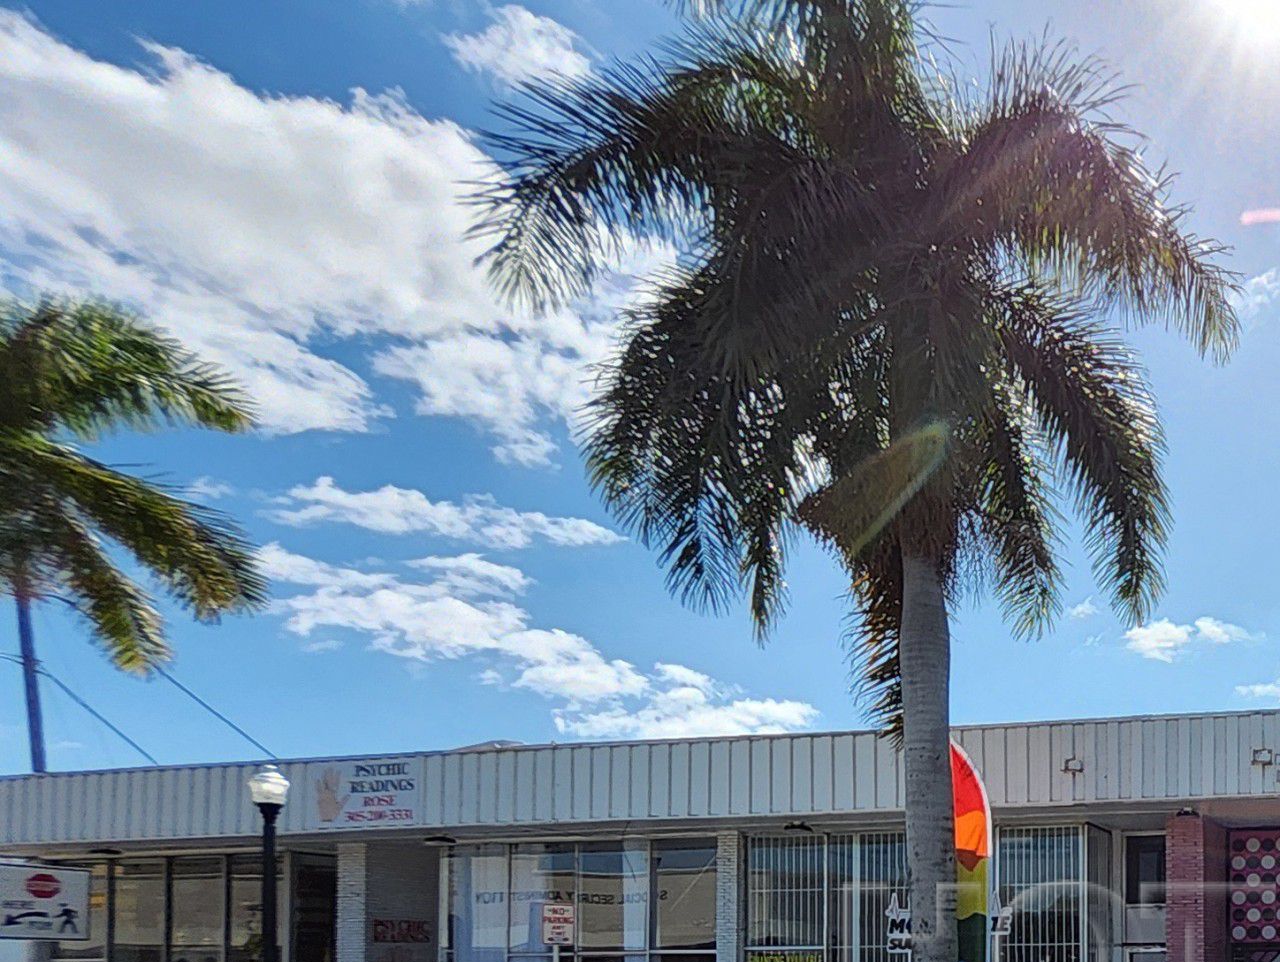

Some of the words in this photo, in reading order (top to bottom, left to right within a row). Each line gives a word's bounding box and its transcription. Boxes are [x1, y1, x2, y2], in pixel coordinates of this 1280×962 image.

[354, 762, 411, 777] PSYCHIC
[349, 779, 416, 793] READINGS
[552, 907, 565, 916] NO
[543, 916, 574, 924] PARKING
